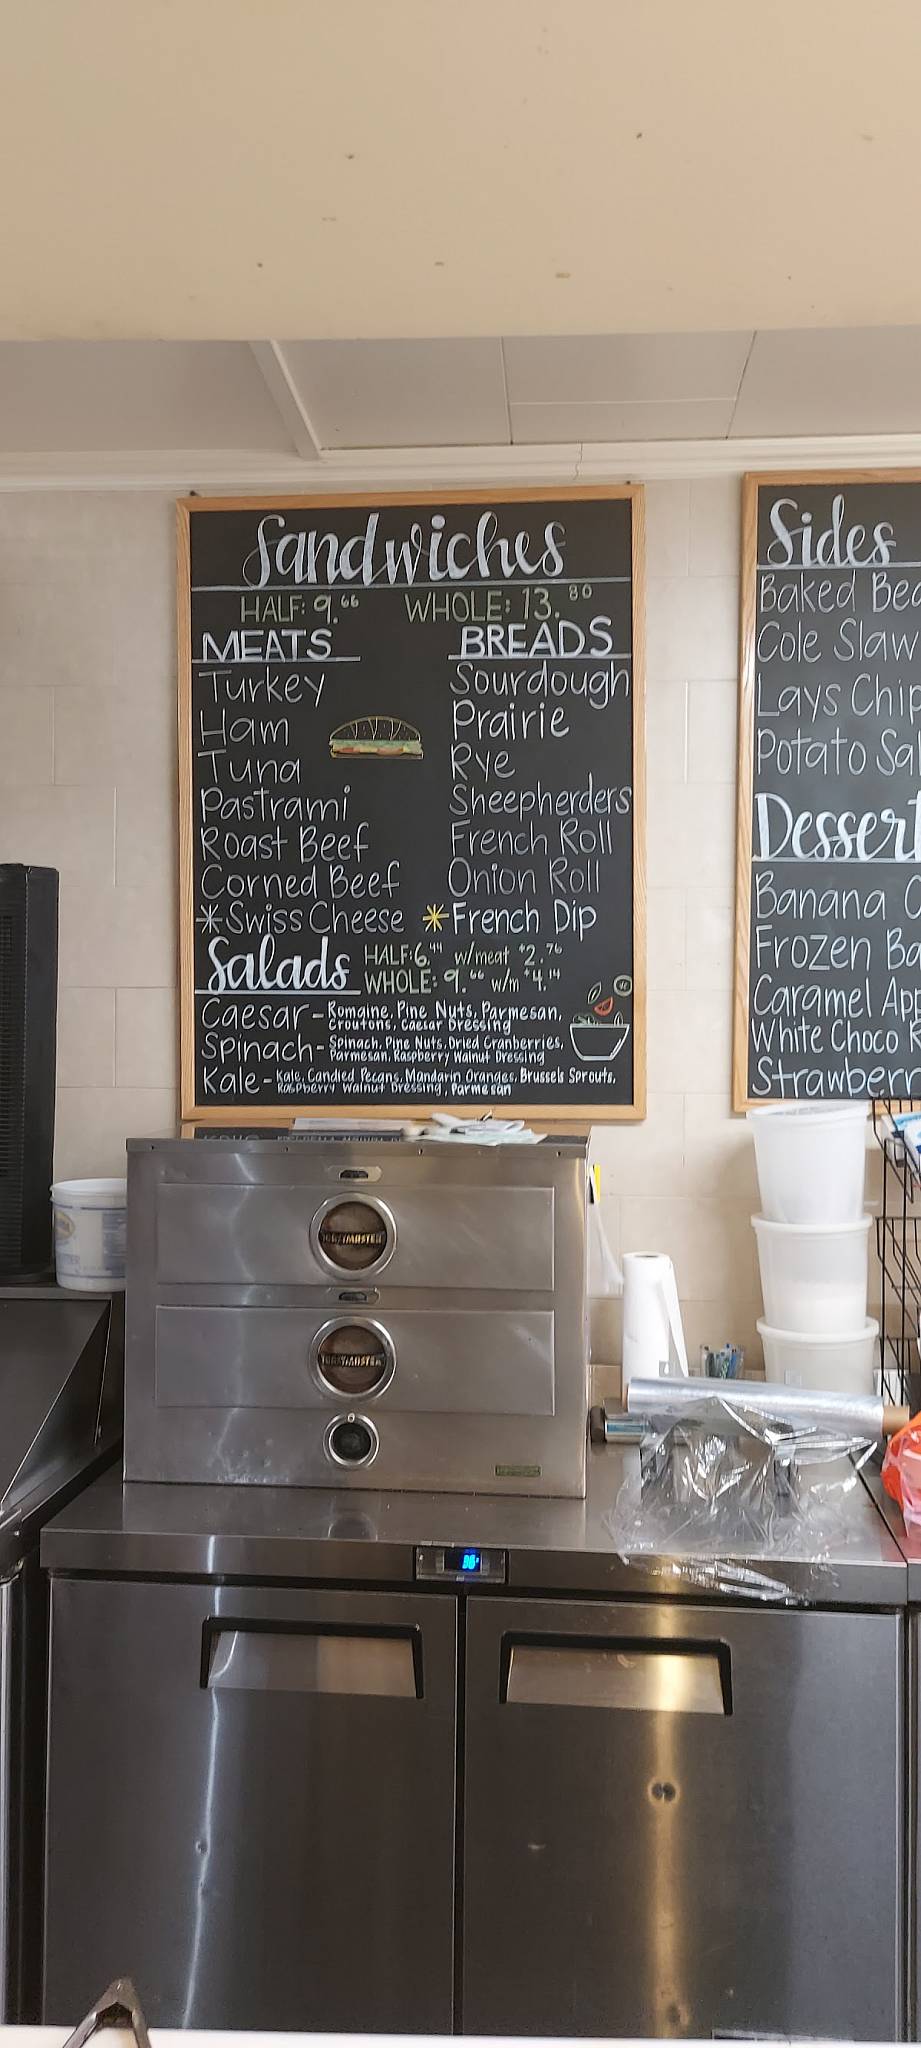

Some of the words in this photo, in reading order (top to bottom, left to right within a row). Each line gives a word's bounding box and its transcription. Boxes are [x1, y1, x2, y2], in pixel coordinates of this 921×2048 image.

[242, 511, 566, 588] Sandwiches
[767, 493, 896, 567] Sides
[240, 594, 305, 623] HALF:
[405, 589, 511, 623] WHOLE:
[760, 570, 856, 614] Baked
[202, 628, 332, 662] MEATS
[461, 615, 613, 659] BREADS
[757, 620, 821, 663] Cole
[833, 617, 919, 662] Slaw
[198, 665, 326, 708] Turkey
[450, 660, 630, 709] Sourdough
[757, 673, 841, 723] Lays
[851, 673, 921, 725] Chip
[200, 708, 289, 746] Ham
[453, 699, 570, 741] Prairie
[198, 749, 300, 784] Tuna
[450, 742, 516, 782] Rye
[757, 727, 866, 776] Potato
[201, 785, 351, 823] Pastrami
[449, 772, 632, 822] Sheepherders
[201, 825, 288, 861] Roast
[300, 821, 369, 864] Beef
[451, 819, 548, 857] French
[560, 818, 613, 855] Roll
[201, 864, 318, 900] Corned
[329, 860, 400, 899] Beef
[448, 857, 536, 897] Onion
[549, 857, 600, 895] Roll
[755, 870, 886, 920] Banana
[309, 900, 404, 934] Cheese
[452, 900, 540, 935] French
[554, 898, 597, 941] Dip
[207, 933, 350, 995] Salads
[755, 924, 872, 971] Frozen
[364, 968, 437, 995] WHOLE:
[753, 973, 872, 1018] Caramel
[328, 1000, 394, 1019] Romaine,
[397, 1000, 427, 1019] Pine
[435, 999, 477, 1019] Nuts,
[482, 1000, 562, 1021] Parmesan,
[328, 1019, 397, 1031] Croutons,
[401, 1019, 443, 1031] Caesar
[448, 1018, 511, 1036] Dressing
[329, 1034, 382, 1050] Spinach,
[385, 1035, 410, 1050] Pine
[415, 1035, 447, 1050] Nuts,
[448, 1034, 479, 1050] Dried
[483, 1034, 564, 1050] Cranberries,
[751, 1016, 823, 1054] White
[831, 1018, 899, 1054] Choco
[276, 1068, 305, 1082] Kale,
[307, 1067, 355, 1083] Candied
[361, 1066, 403, 1083] Pecans,
[405, 1067, 461, 1083] Mandarin
[466, 1068, 518, 1084] Oranges,
[520, 1066, 564, 1084] Brussels
[568, 1066, 616, 1084] Sprouts,
[330, 1048, 391, 1062] Parmesan,
[393, 1049, 450, 1068] Raspberry
[454, 1050, 490, 1064] Walnut
[496, 1050, 545, 1066] Dressing
[277, 1081, 335, 1094] Raspberry
[342, 1081, 385, 1094] Walnut
[451, 1082, 512, 1096] Parmesan
